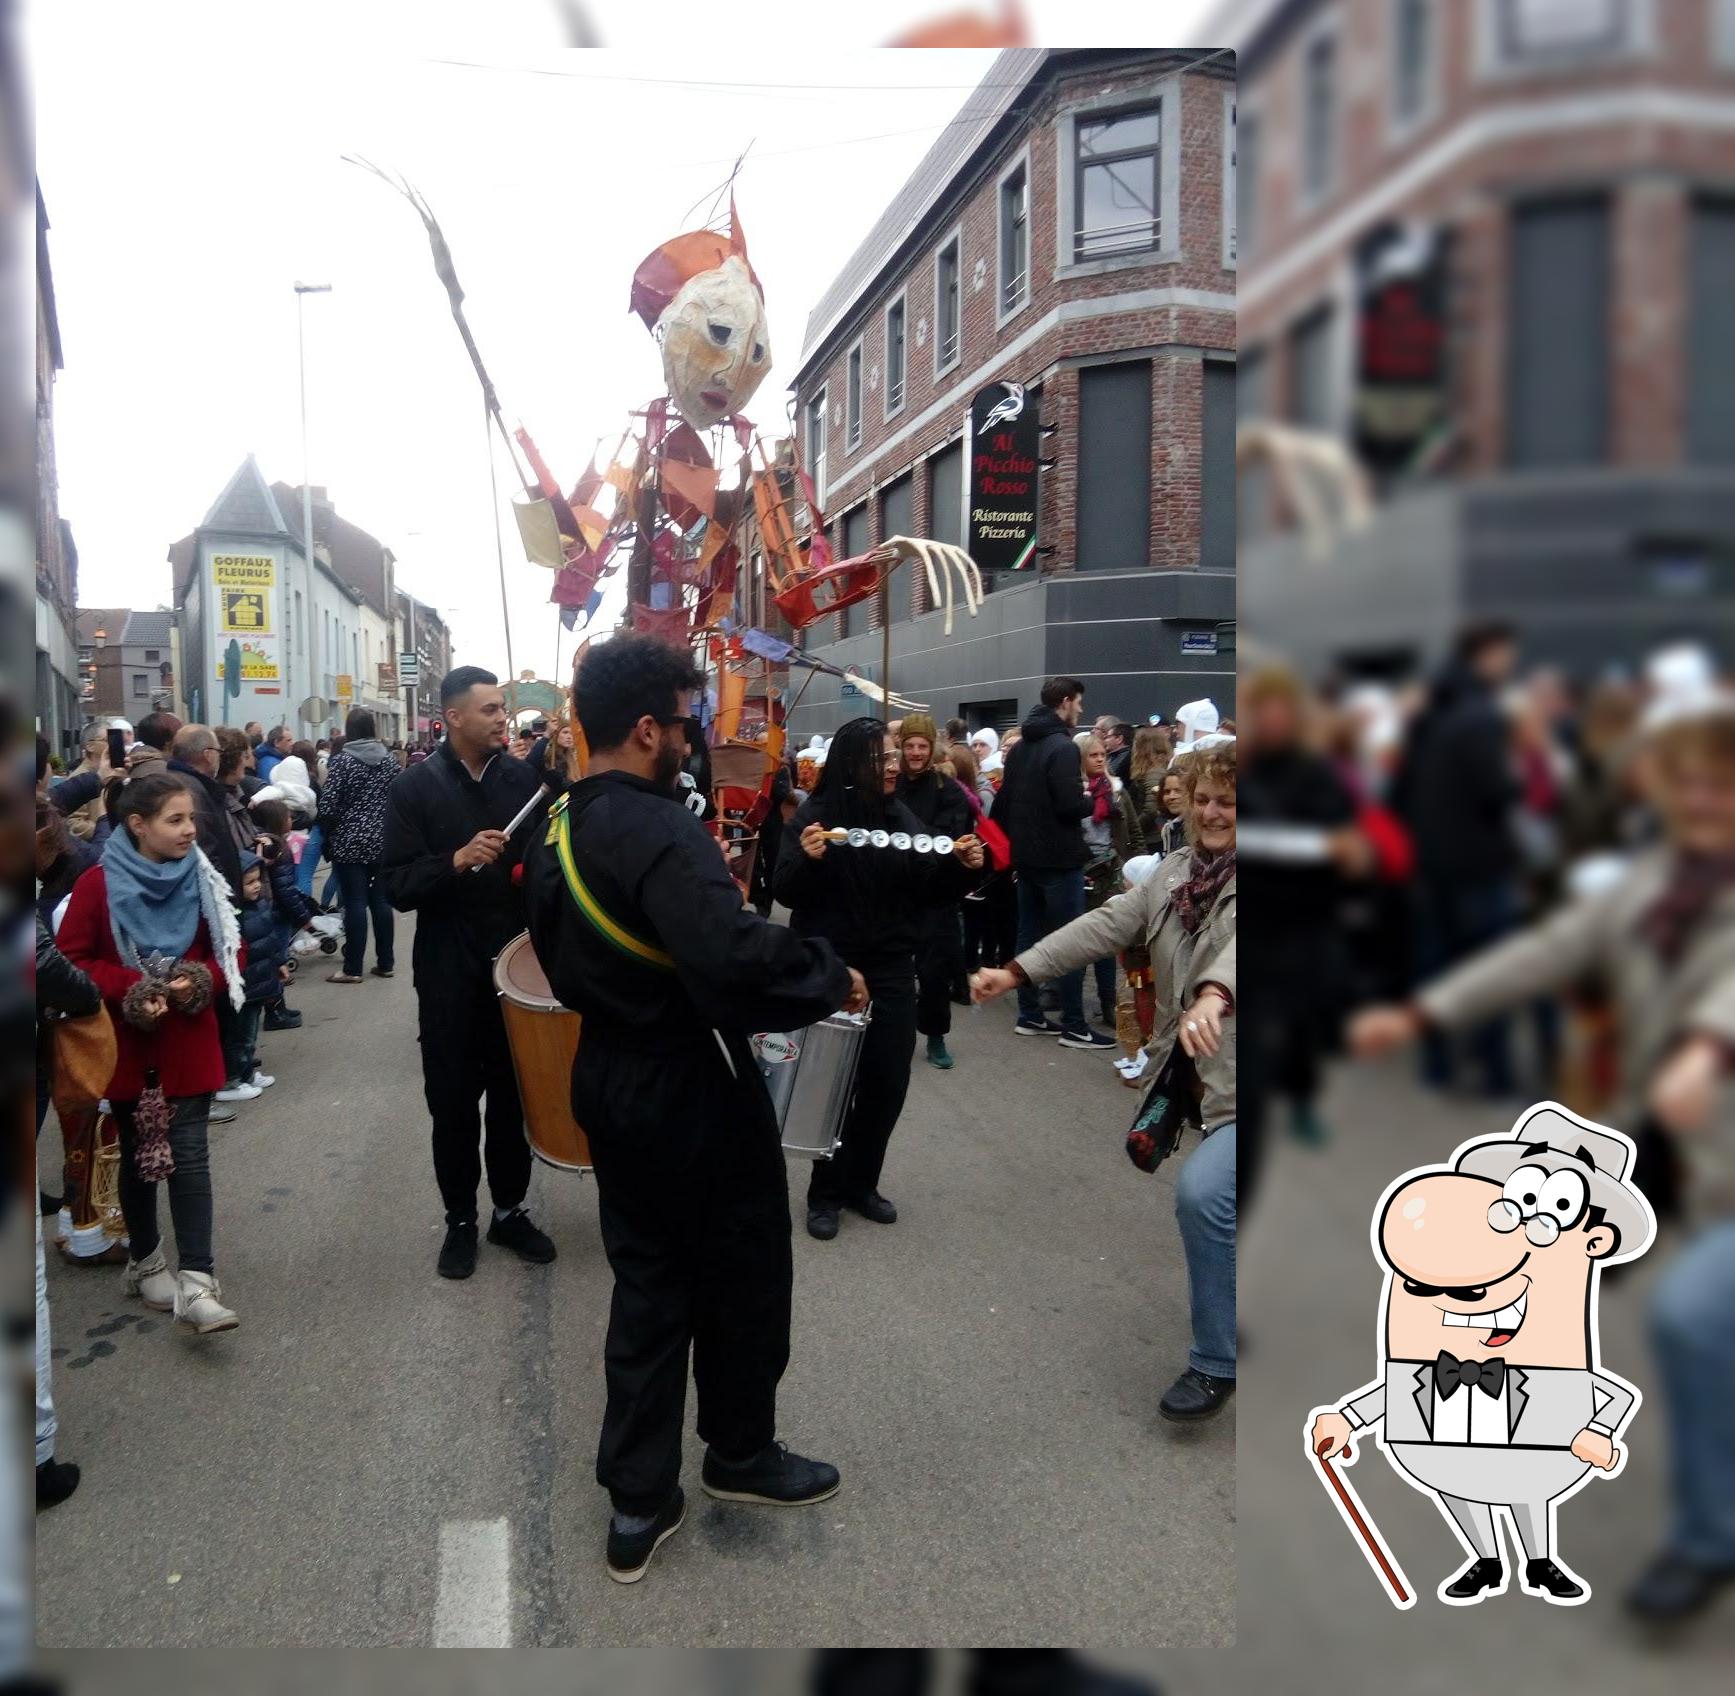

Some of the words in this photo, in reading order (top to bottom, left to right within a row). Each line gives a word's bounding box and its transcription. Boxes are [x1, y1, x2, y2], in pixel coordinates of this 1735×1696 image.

[992, 433, 1016, 452] Al
[975, 453, 1035, 473] Picchio
[979, 476, 1030, 495] Rosso
[972, 508, 1034, 523] Ristorante
[979, 525, 1026, 539] Pizzeria
[214, 557, 273, 567] GOFFAUX
[218, 567, 270, 578] FLEURUS
